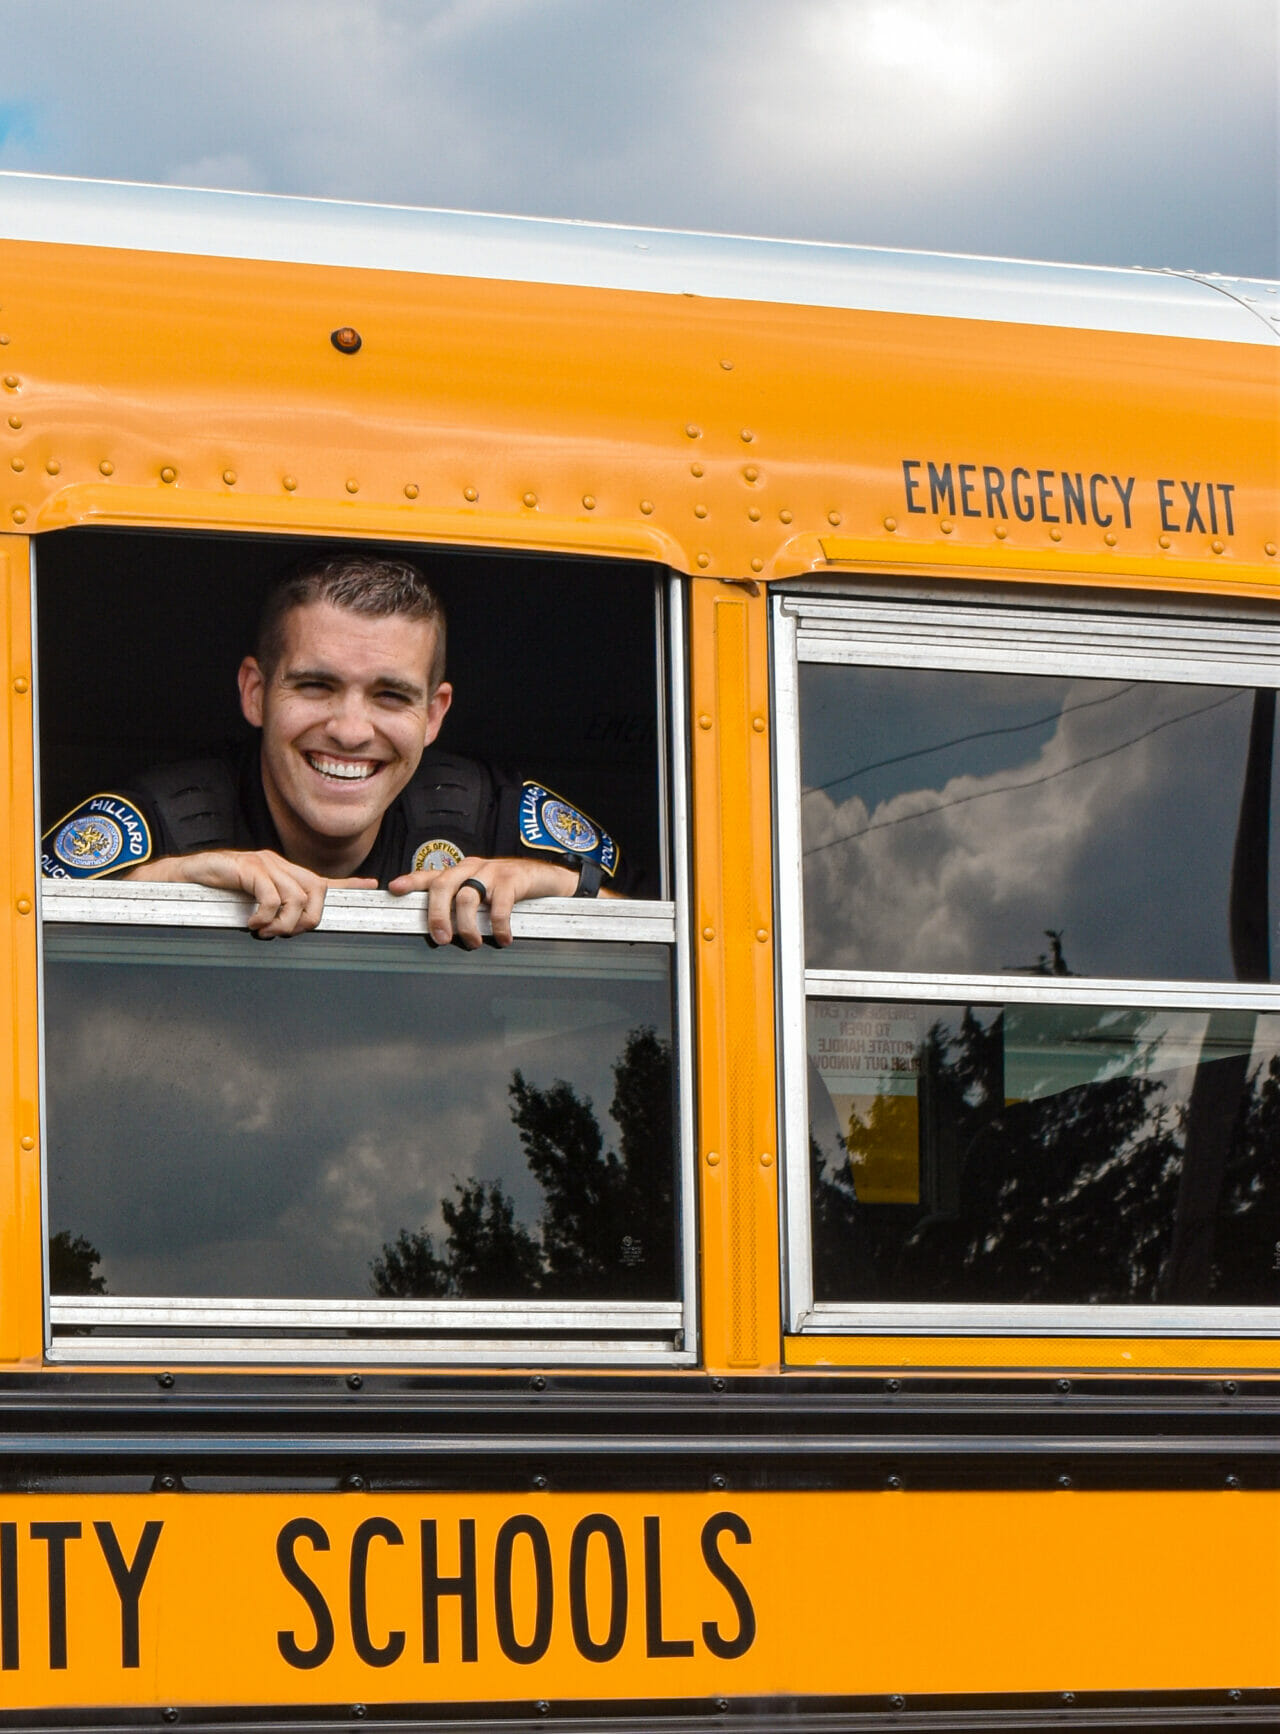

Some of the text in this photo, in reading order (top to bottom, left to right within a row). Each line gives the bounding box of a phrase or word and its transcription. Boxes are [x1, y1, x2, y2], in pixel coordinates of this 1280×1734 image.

[902, 460, 1235, 536] EMERGENCY EXIT
[90, 799, 142, 855] HILLIARD
[276, 1511, 756, 1670] SCHOOLS
